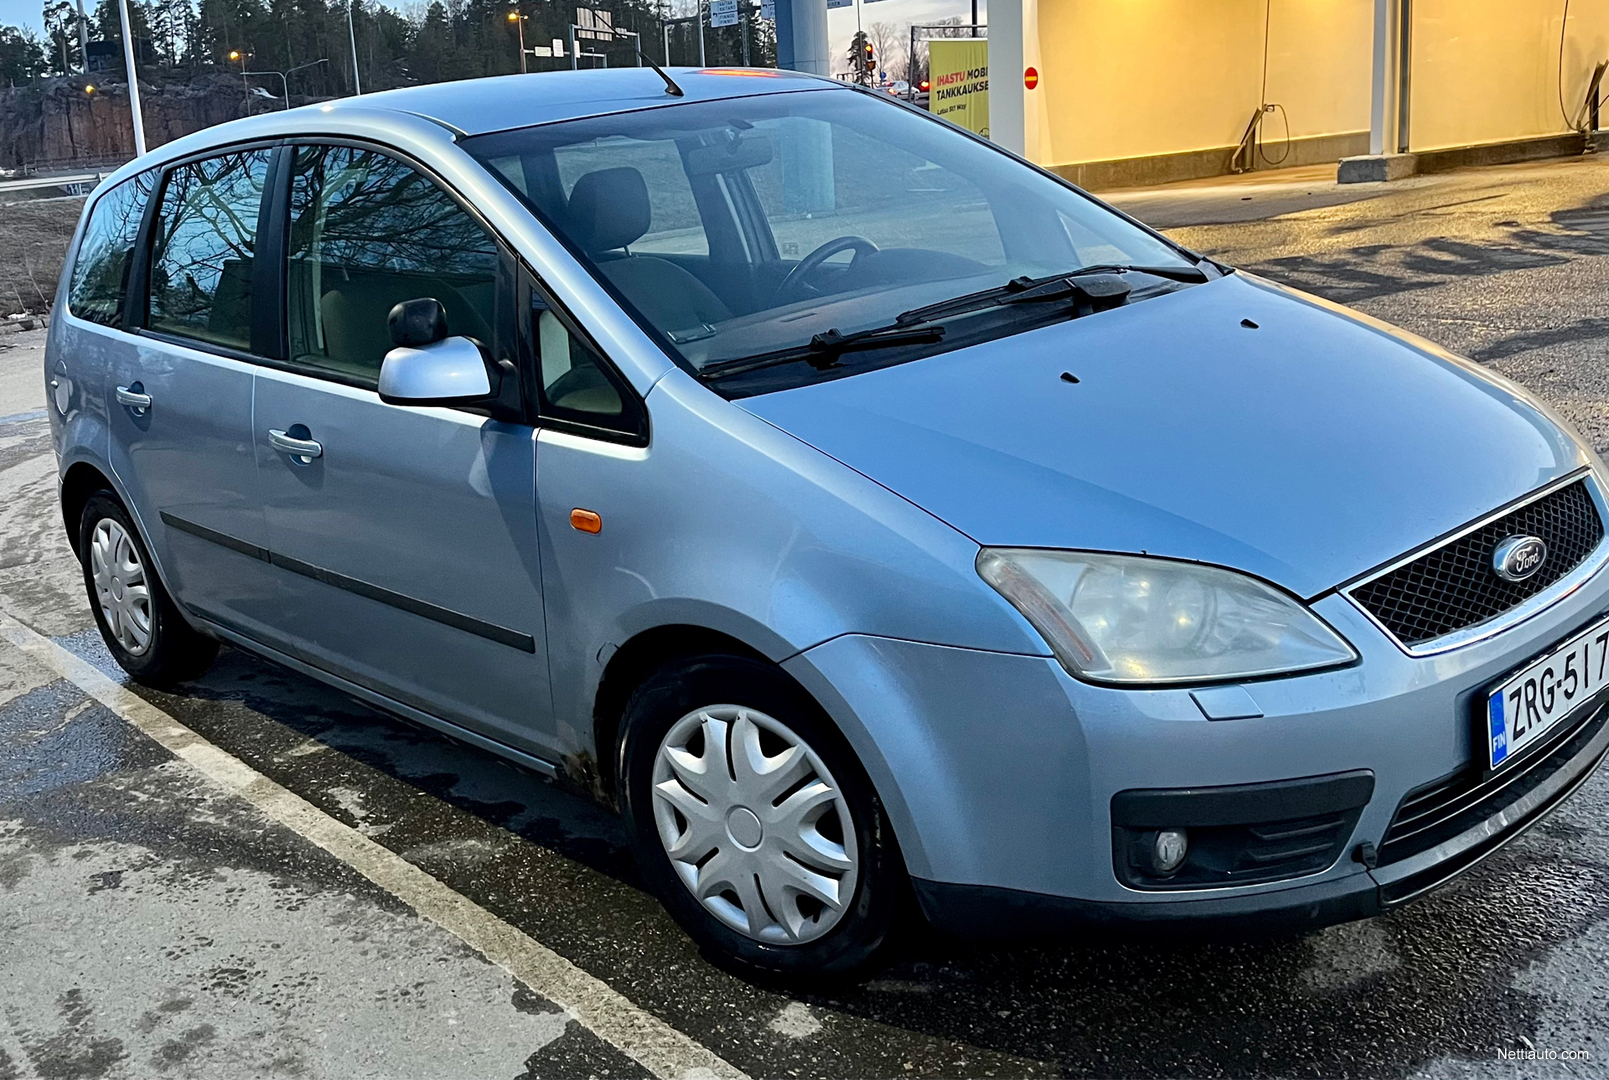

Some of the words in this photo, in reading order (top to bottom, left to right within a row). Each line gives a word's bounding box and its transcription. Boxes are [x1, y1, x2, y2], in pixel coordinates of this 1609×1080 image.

[937, 71, 965, 86] IHASTU
[936, 80, 988, 100] TANKKAUKSE
[1516, 546, 1540, 572] Ford
[1509, 630, 1609, 742] ZRG-517
[1493, 731, 1505, 752] FIN
